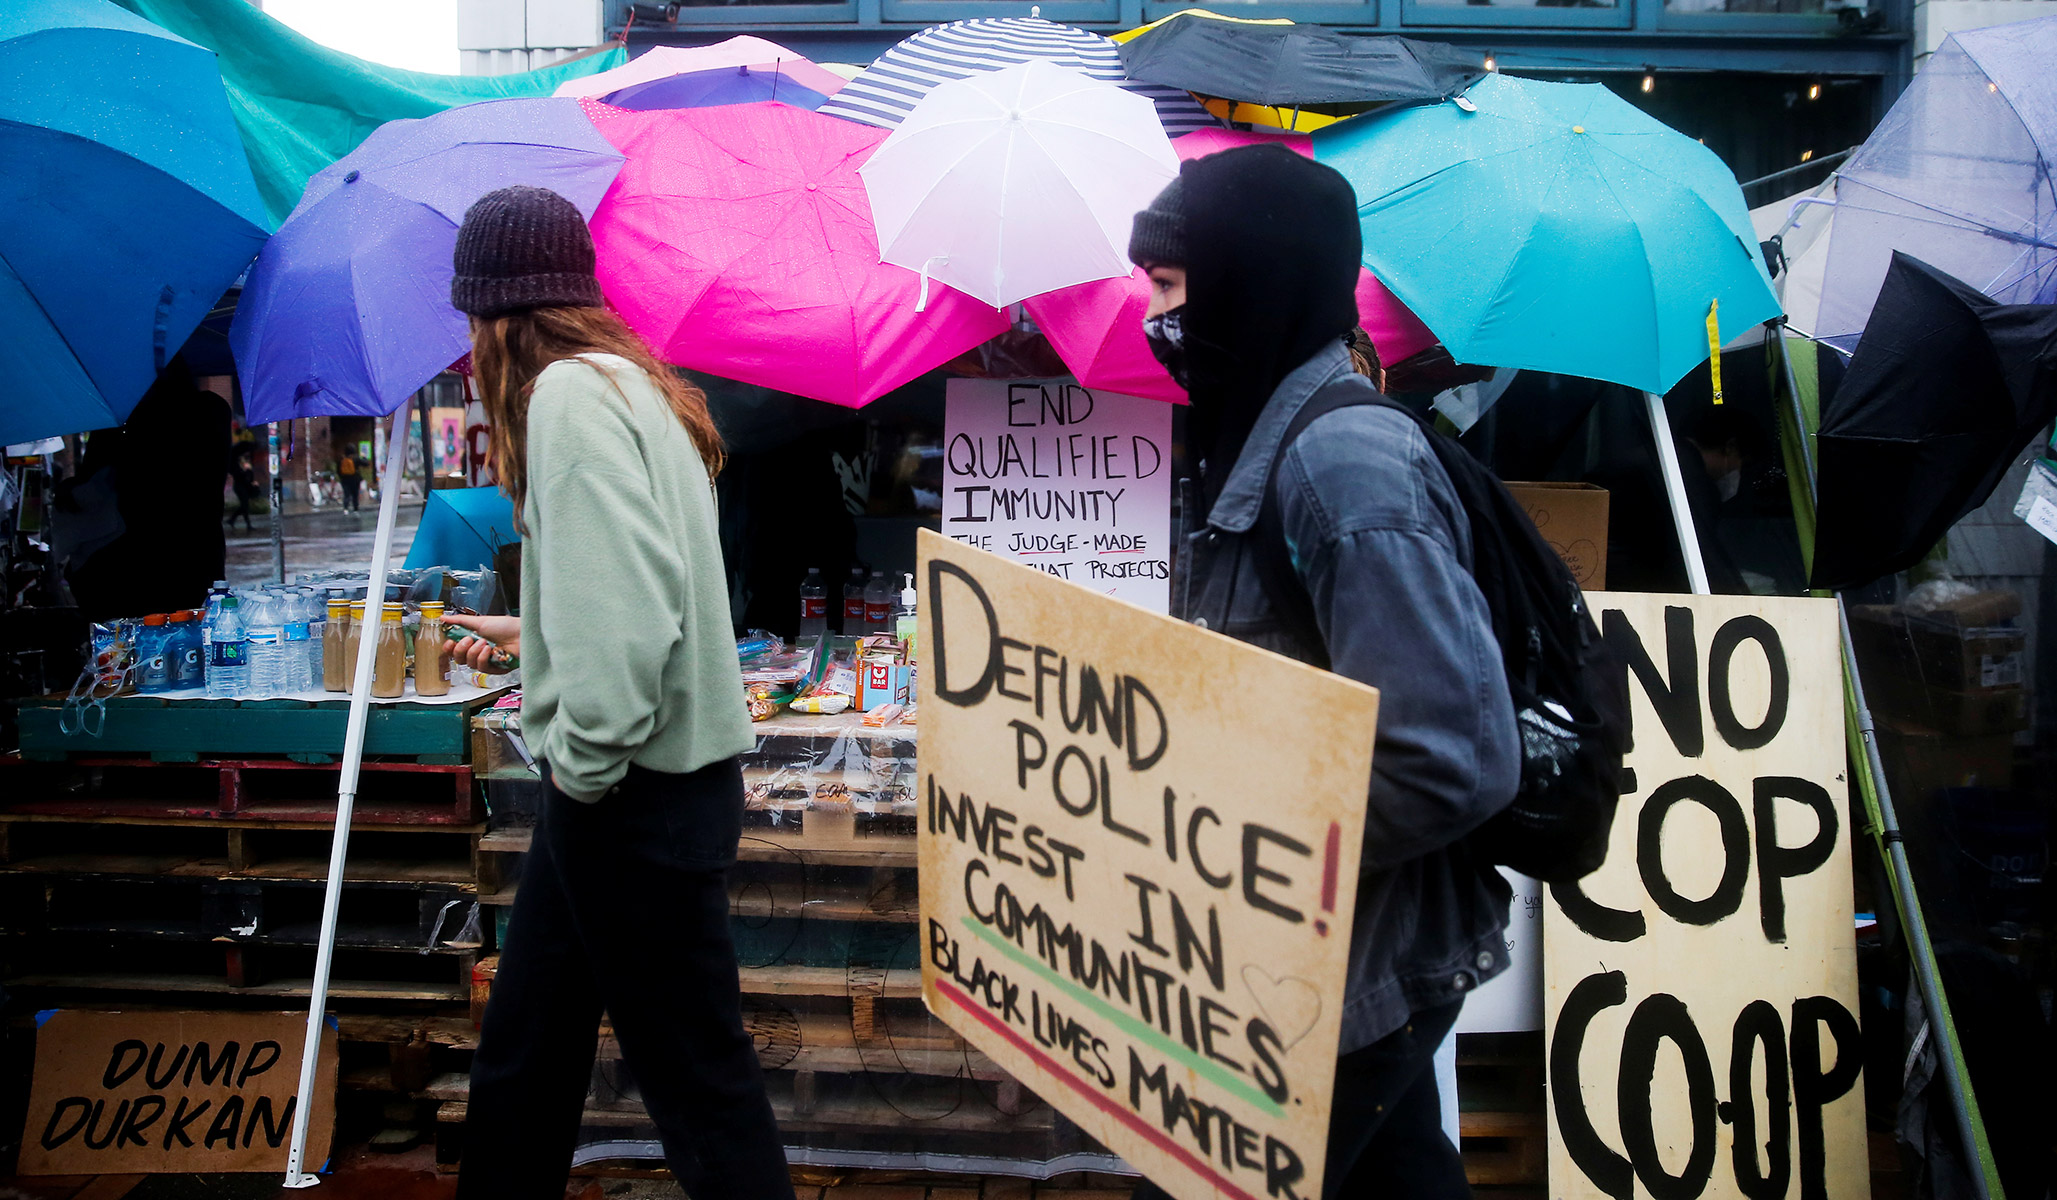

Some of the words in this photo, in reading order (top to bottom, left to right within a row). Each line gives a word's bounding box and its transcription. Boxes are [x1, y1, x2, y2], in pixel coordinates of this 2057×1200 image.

[1007, 383, 1094, 427] END
[947, 432, 1162, 480] QUALIFIED
[949, 485, 1126, 527] IMMUNITY
[1025, 562, 1074, 580] AT
[1085, 559, 1169, 580] PROTECTS
[150, 655, 164, 670] G
[185, 649, 198, 664] G
[928, 558, 1168, 771] DEFUND
[1601, 605, 1790, 758] NO
[1007, 718, 1341, 938] POLICE!
[927, 773, 1085, 901] INVEST
[1124, 873, 1225, 992] IN
[928, 917, 1026, 1026] BLACK
[1031, 990, 1116, 1090] LIVES
[964, 859, 1304, 1106] COMMUNITIES.
[102, 1039, 282, 1090] DUMP
[1551, 969, 1863, 1200] CO-OP
[41, 1094, 298, 1152] DURKAN
